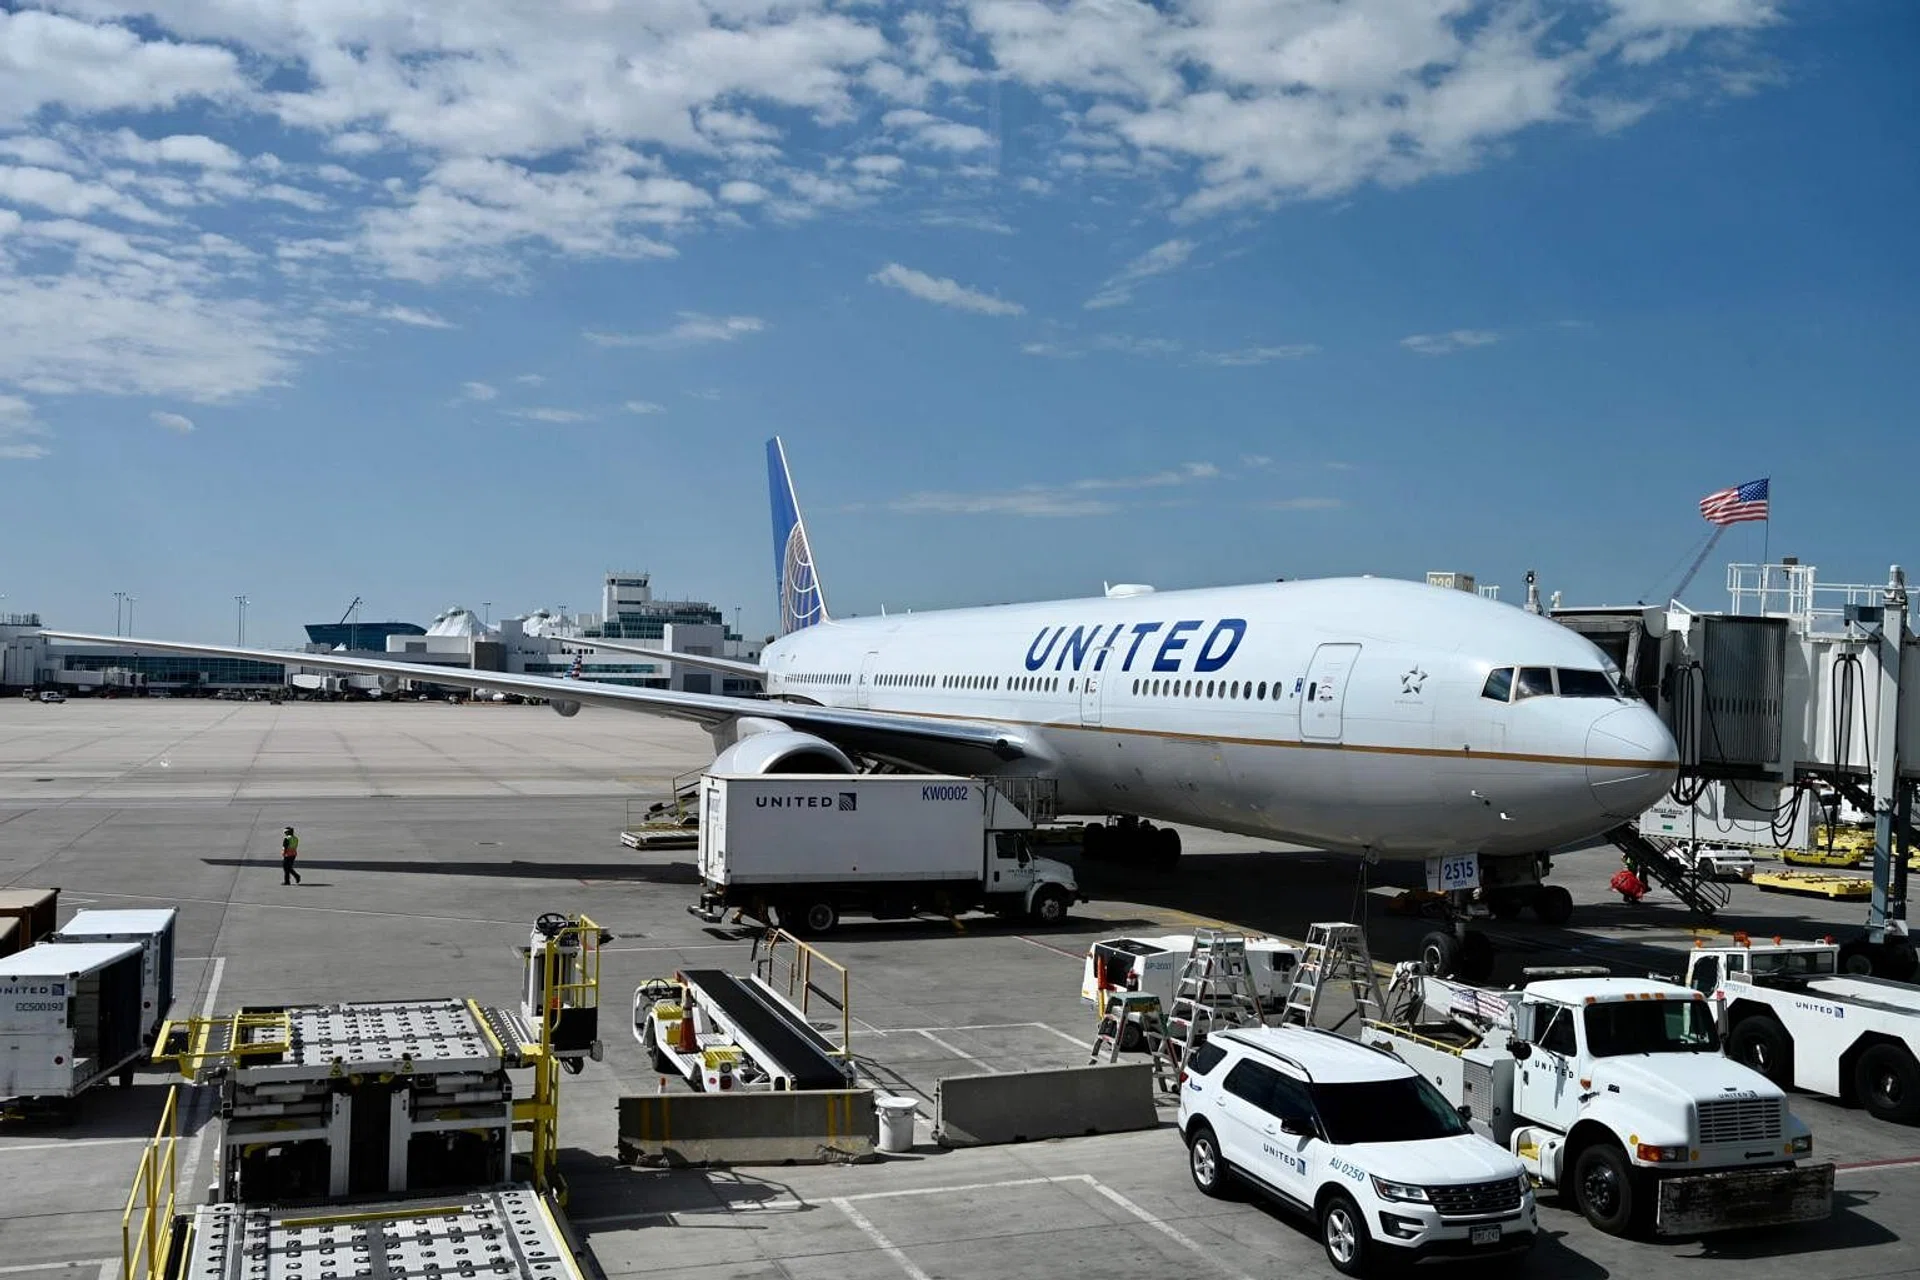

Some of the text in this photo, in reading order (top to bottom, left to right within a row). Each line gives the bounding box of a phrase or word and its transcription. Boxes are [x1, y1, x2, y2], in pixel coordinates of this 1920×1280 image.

[1025, 618, 1247, 672] UNITED
[756, 796, 833, 808] UNITED
[922, 786, 968, 801] KW0002
[1444, 861, 1474, 880] 2515
[1796, 1002, 1832, 1014] UNITED
[1535, 1060, 1574, 1078] UNITED
[1263, 1143, 1296, 1166] UNITED
[1329, 1157, 1365, 1182] AU 0250
